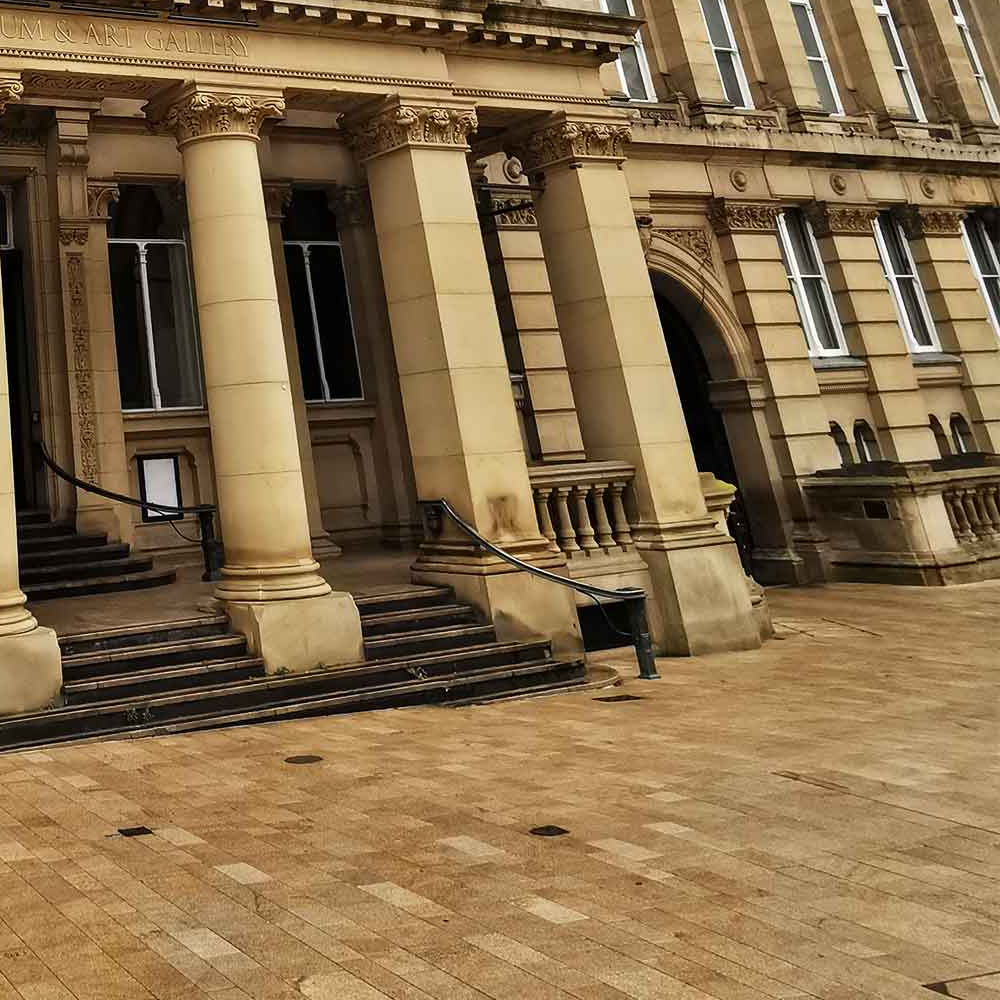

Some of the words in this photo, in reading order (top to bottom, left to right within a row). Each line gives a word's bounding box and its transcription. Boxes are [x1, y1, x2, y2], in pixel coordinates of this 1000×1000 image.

[53, 18, 75, 44] &
[84, 23, 133, 49] ART
[144, 27, 250, 58] GALLERY
